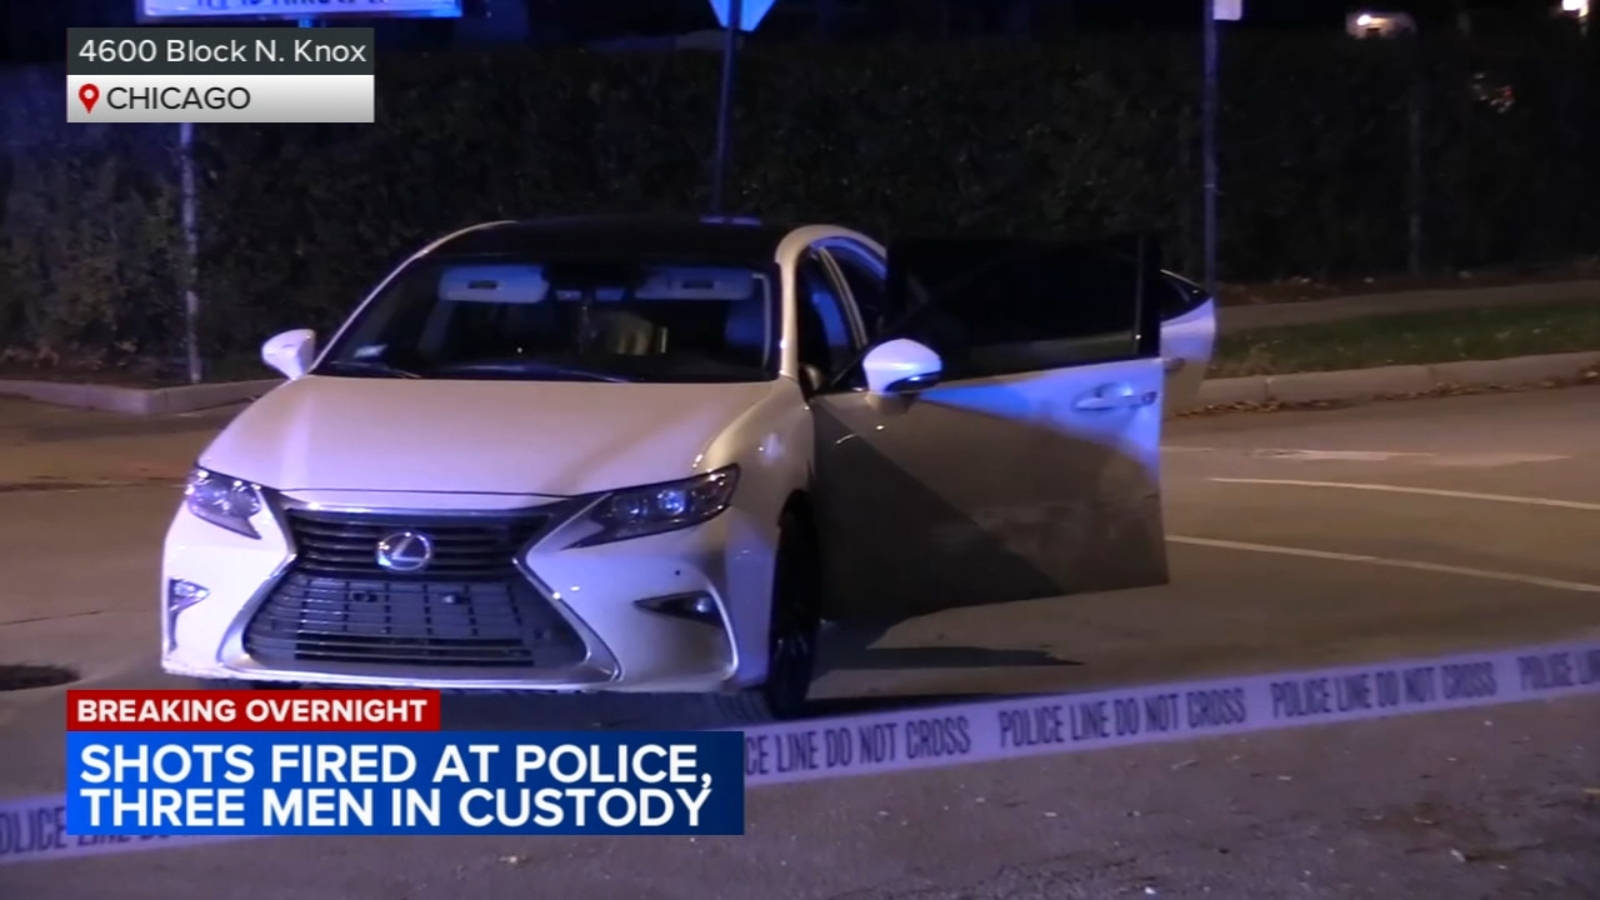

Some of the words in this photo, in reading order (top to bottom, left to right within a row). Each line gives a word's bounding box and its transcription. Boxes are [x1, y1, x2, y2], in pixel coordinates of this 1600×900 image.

[998, 705, 1065, 748] POLICE
[1069, 701, 1110, 741] LINE
[1113, 697, 1140, 736] DO
[1144, 693, 1180, 732] NOT
[1186, 687, 1247, 728] CROSS
[1270, 677, 1332, 718] POLICE
[1333, 673, 1372, 712] LINE
[1375, 671, 1400, 708] DO
[1403, 666, 1435, 704] NOT
[1441, 661, 1497, 700] CROSS
[776, 731, 820, 773] LINE
[824, 727, 853, 768] DO
[859, 722, 898, 764] NOT
[905, 716, 971, 760] CROSS
[0, 806, 68, 855] OLICE
